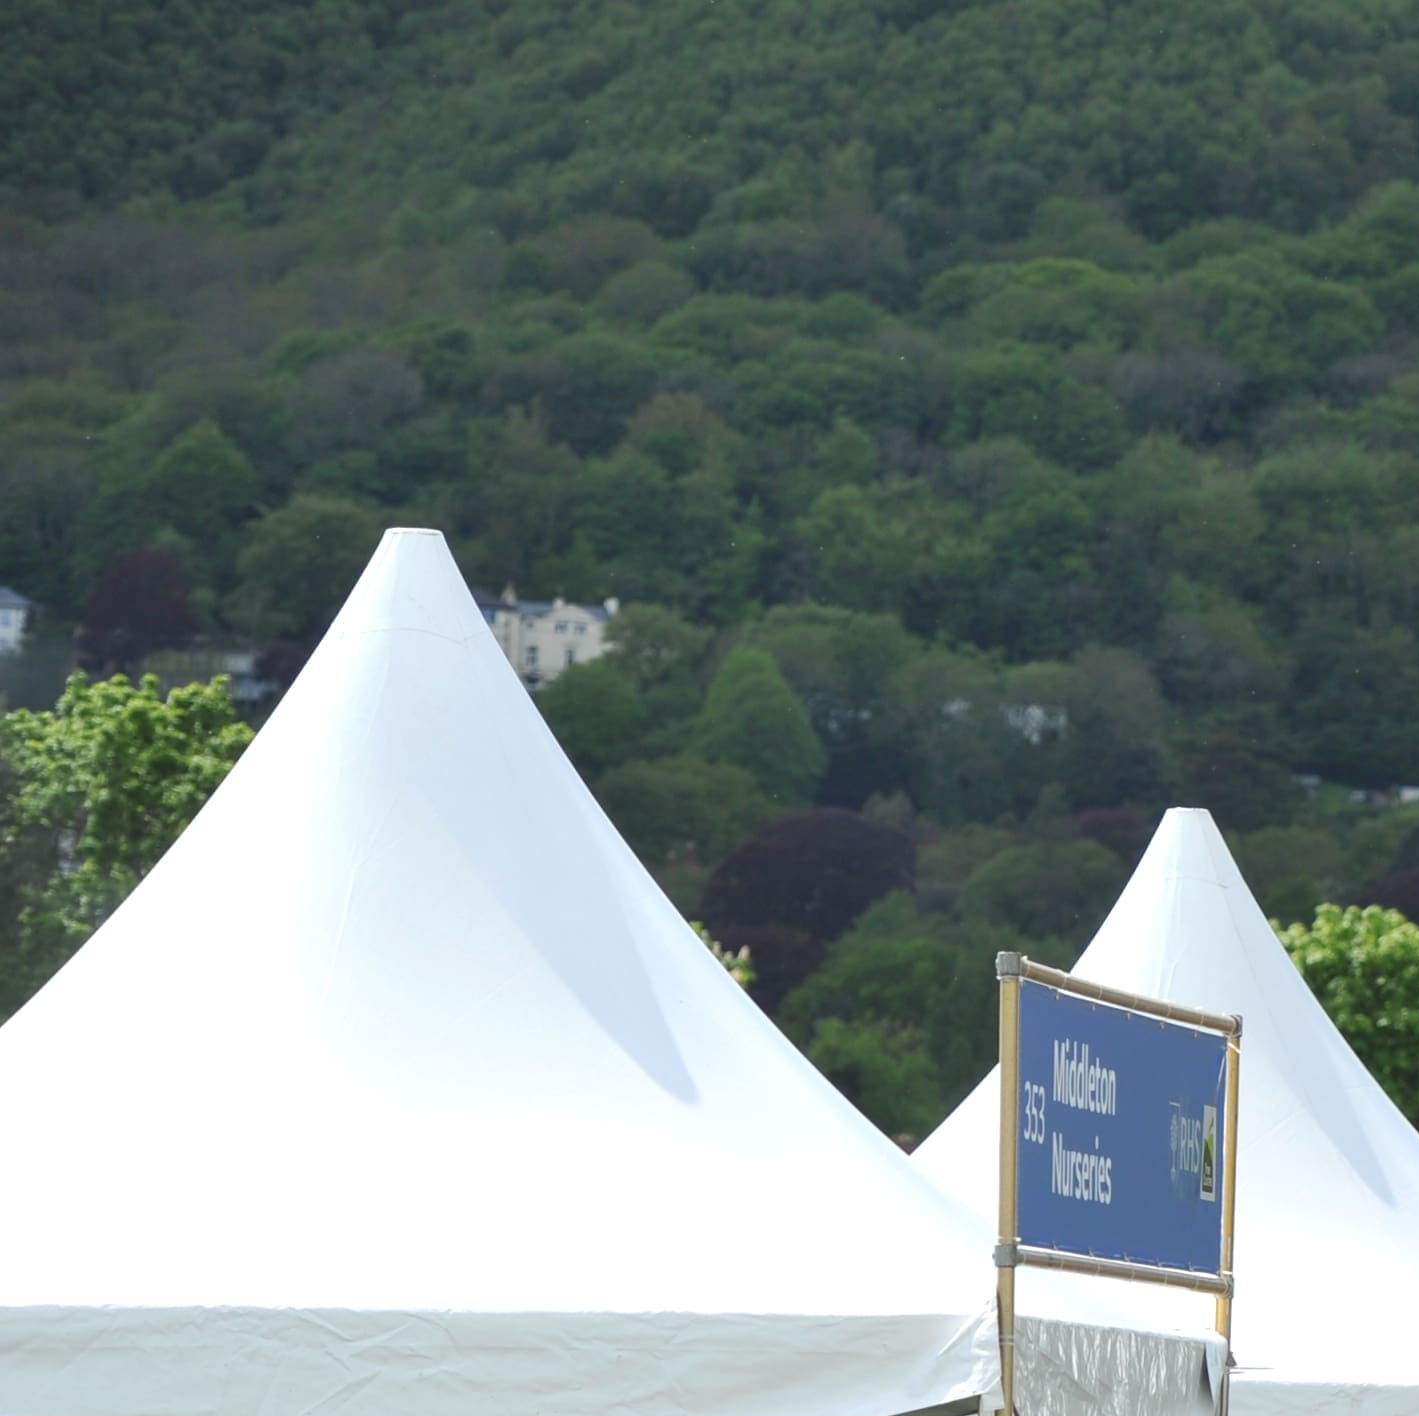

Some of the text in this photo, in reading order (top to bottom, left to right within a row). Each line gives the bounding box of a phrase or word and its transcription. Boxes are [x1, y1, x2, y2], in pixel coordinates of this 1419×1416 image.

[1053, 1038, 1117, 1117] Middleton
[1024, 1080, 1046, 1145] 353
[1180, 1116, 1201, 1174] RHS
[1051, 1132, 1113, 1206] Nurseries
